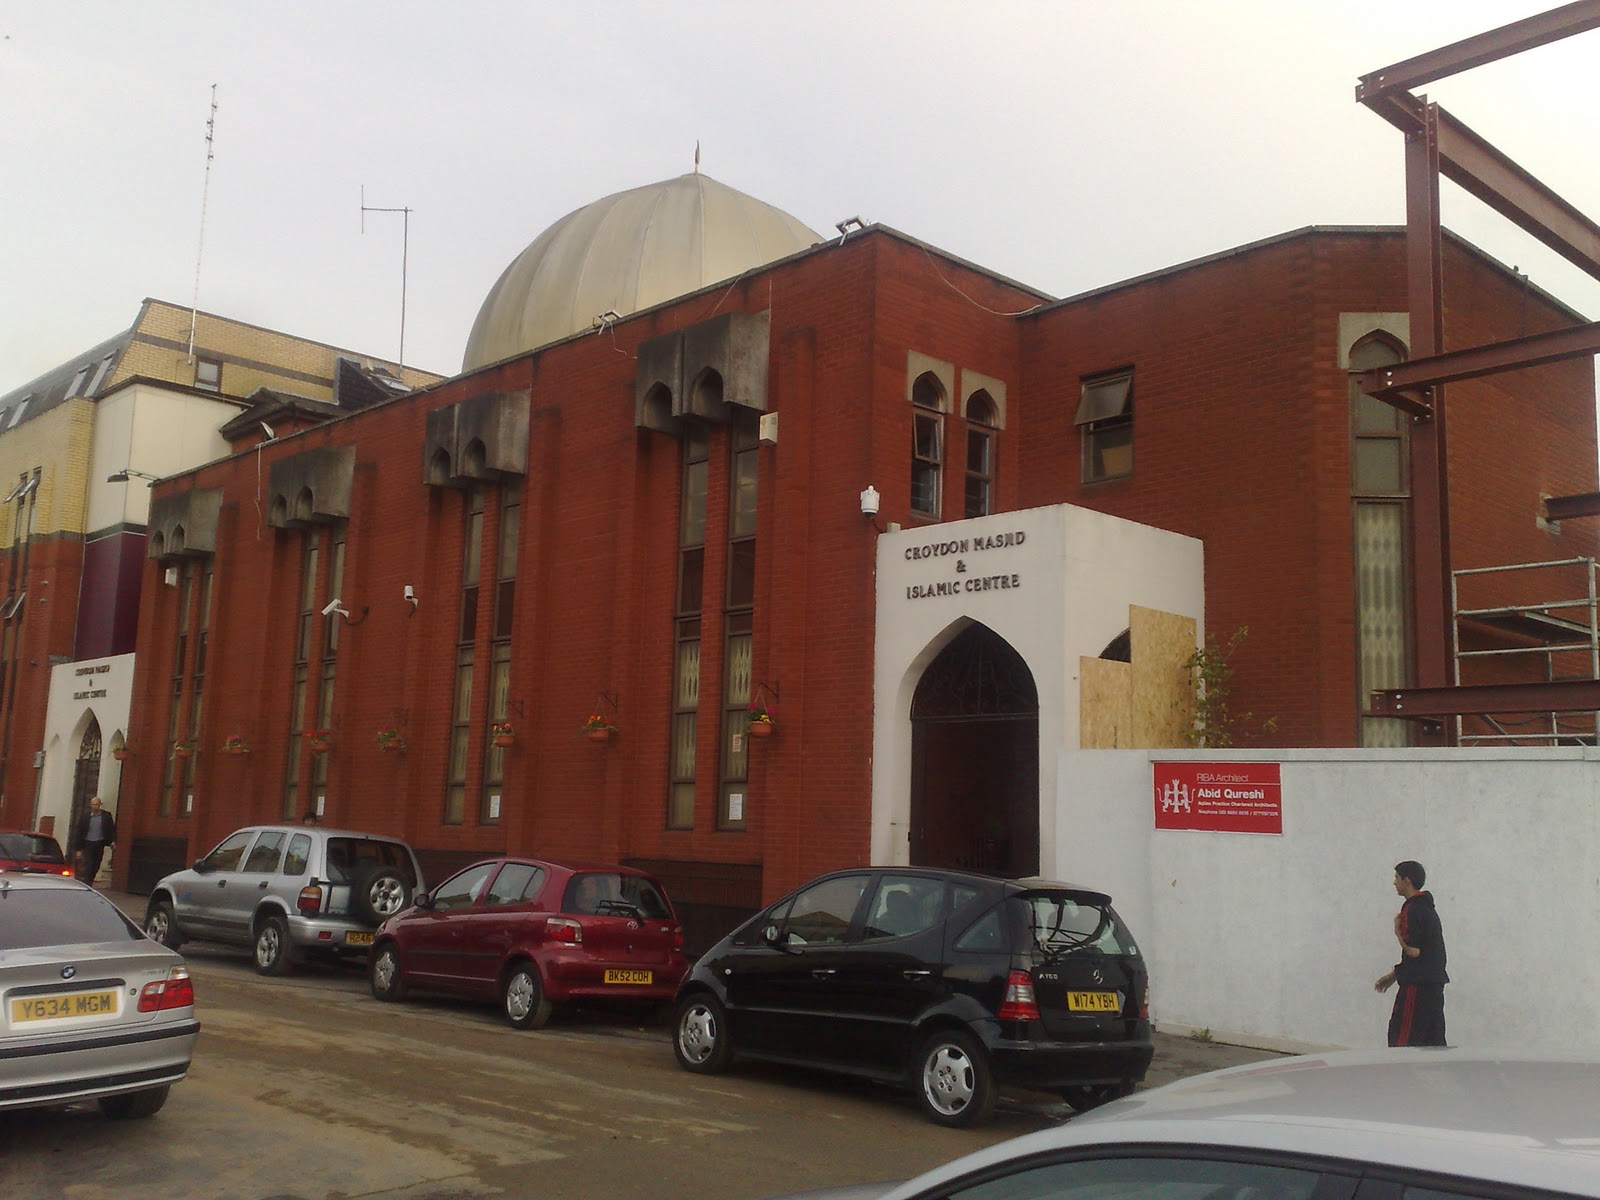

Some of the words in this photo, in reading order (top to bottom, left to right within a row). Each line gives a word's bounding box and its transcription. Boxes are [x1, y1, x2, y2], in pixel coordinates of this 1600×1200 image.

[904, 539, 969, 560] CROYDON
[973, 531, 1026, 551] MASJID
[956, 560, 966, 573] &
[906, 581, 960, 599] ISLAMIC
[965, 574, 1020, 592] CENTRE
[1216, 774, 1248, 782] Architect
[1197, 788, 1221, 798] Abid
[1224, 789, 1264, 799] Qureshi
[608, 970, 631, 982] BK52
[22, 998, 70, 1019] Y634
[76, 995, 111, 1013] MGM
[1073, 993, 1095, 1008] W174
